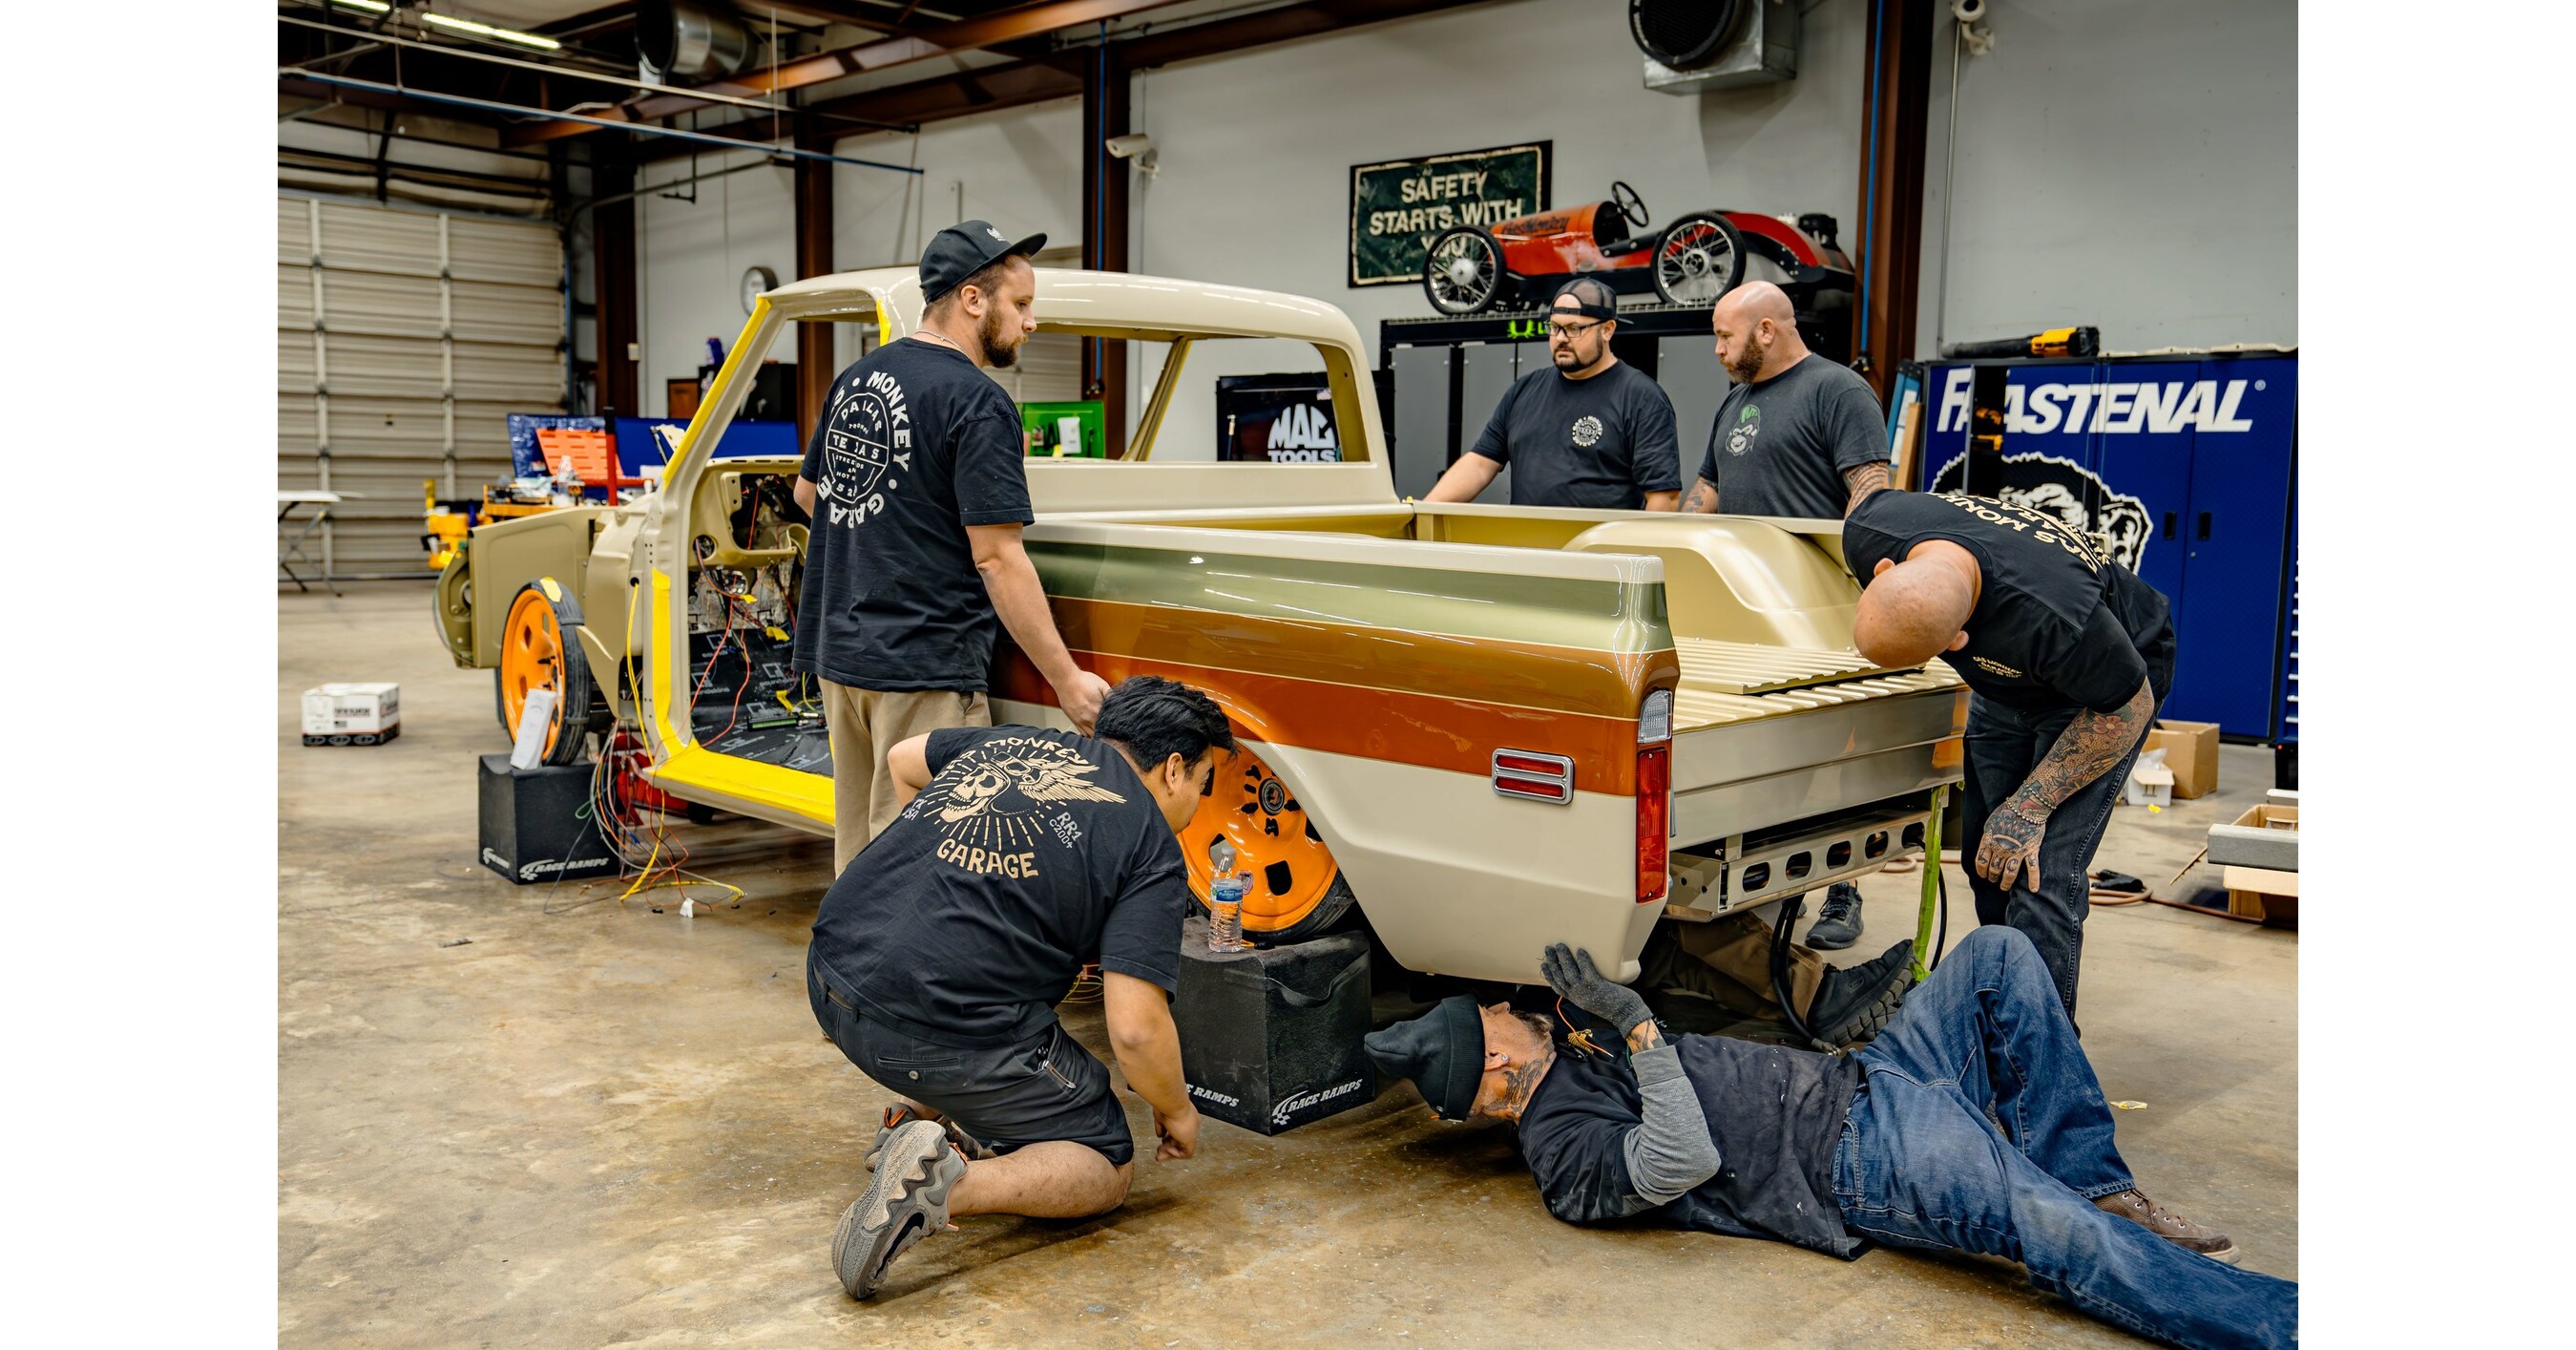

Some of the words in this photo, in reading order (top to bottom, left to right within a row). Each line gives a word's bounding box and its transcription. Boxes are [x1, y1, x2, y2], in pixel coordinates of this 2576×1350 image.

[1400, 170, 1488, 203] SAFETY
[1368, 205, 1454, 236] STARTS
[1460, 198, 1523, 226] WITH
[1937, 368, 2253, 434] FASTENAL
[866, 370, 911, 473] MONKEY
[1267, 403, 1336, 450] MAC
[1267, 449, 1336, 463] TOOLS
[816, 475, 885, 529] GARAE
[1926, 492, 2030, 532] MONK
[984, 736, 1090, 766] MONKEY
[1056, 812, 1083, 841] RR1
[566, 857, 610, 870] RAMPS
[936, 838, 1039, 879] GARAGE
[1190, 1086, 1240, 1108] RAMPS
[1288, 1092, 1321, 1113] RACE
[1319, 1078, 1363, 1102] RAMPS
